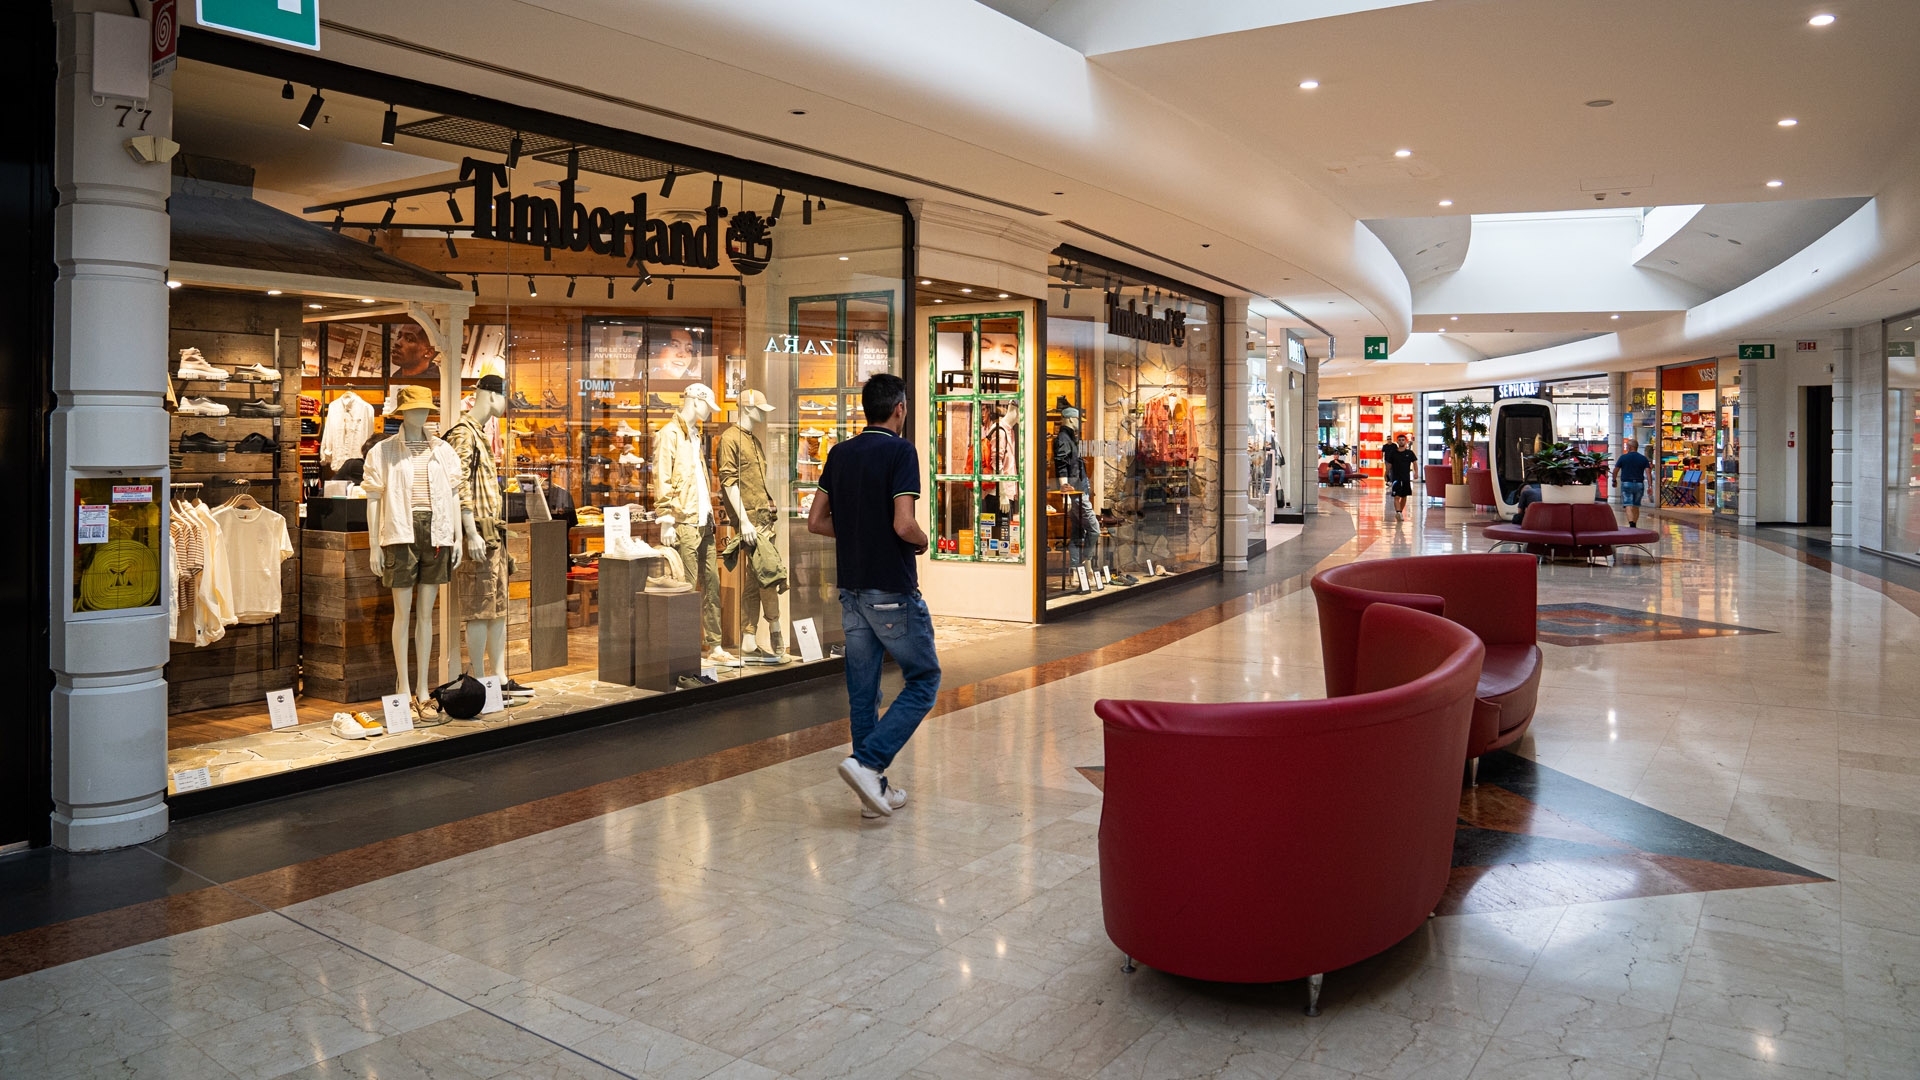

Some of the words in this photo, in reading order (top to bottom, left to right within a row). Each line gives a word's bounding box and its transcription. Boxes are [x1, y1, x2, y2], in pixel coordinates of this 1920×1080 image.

[114, 104, 152, 131] 77
[459, 156, 720, 269] Timberland
[1107, 291, 1172, 345] Timberland
[578, 379, 616, 391] TOMMY
[593, 391, 616, 399] JEANS
[1498, 381, 1537, 398] SEPHORA
